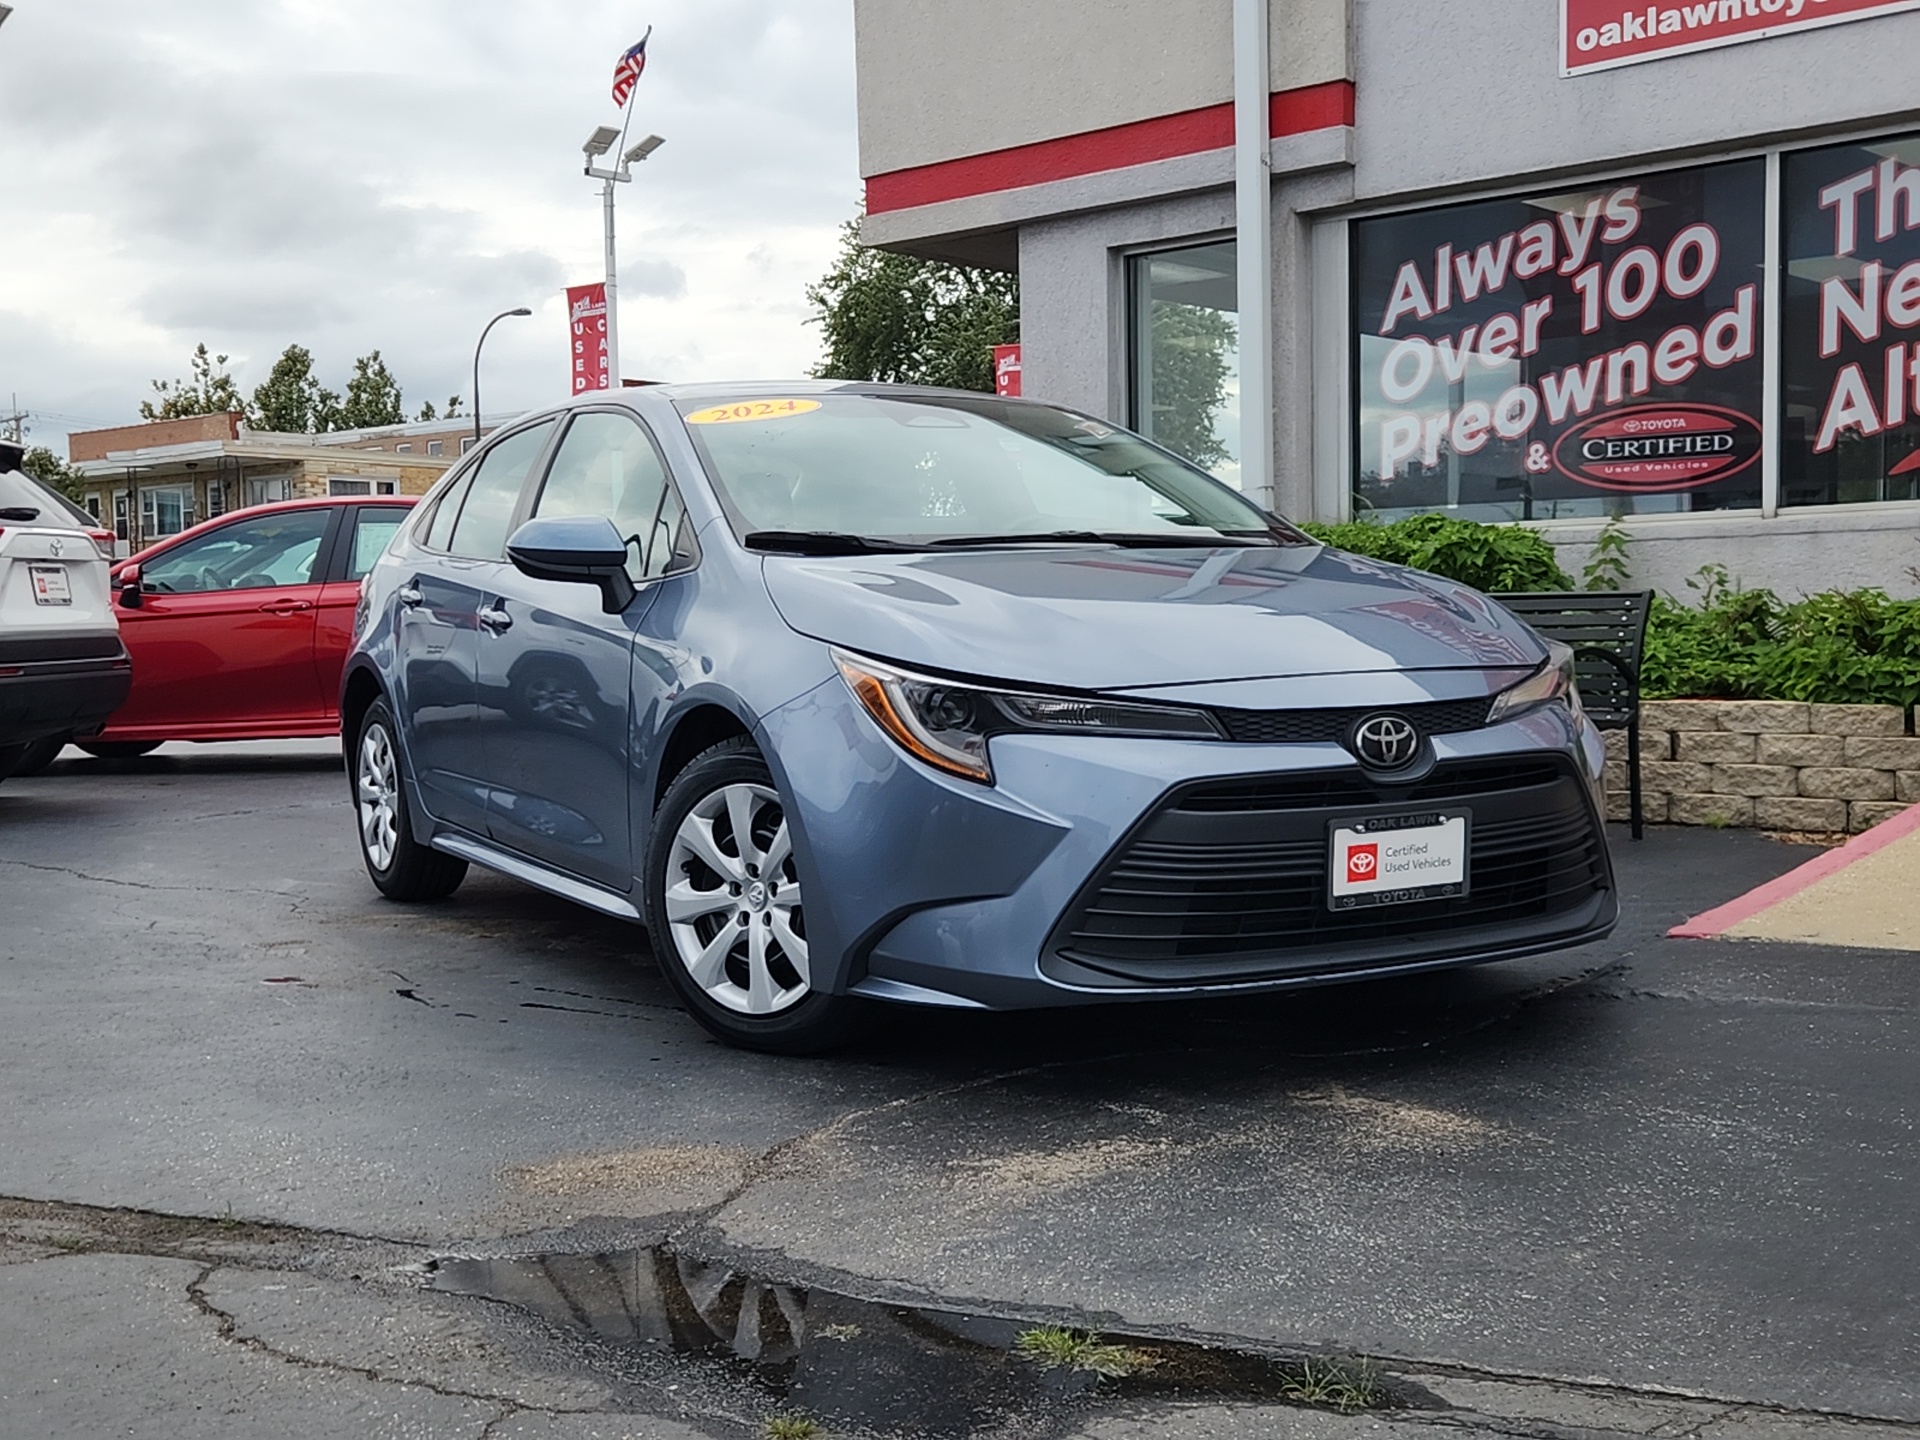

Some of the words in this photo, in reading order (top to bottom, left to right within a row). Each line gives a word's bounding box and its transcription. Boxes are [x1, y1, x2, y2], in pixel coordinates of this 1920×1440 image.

[1575, 0, 1829, 51] oaklawntoy
[1379, 185, 1641, 336] Always
[1379, 295, 1553, 402] Over
[1572, 222, 1720, 334] 100
[573, 322, 586, 390] USED
[597, 319, 609, 387] CARS
[1379, 283, 1757, 481] Preowned
[711, 400, 797, 422] 2024
[1641, 418, 1687, 431] TOYOTA
[1525, 441, 1550, 473] &
[1582, 434, 1734, 460] CERTIFIED
[1604, 465, 1640, 474] Used
[1645, 461, 1709, 472] Vehicles
[1368, 818, 1396, 829] OAK
[1400, 814, 1437, 827] LAWN
[1385, 843, 1428, 858] Certified
[1385, 860, 1410, 873] Used
[1412, 857, 1451, 870] Vehicles
[1373, 888, 1426, 904] TOYOTA
